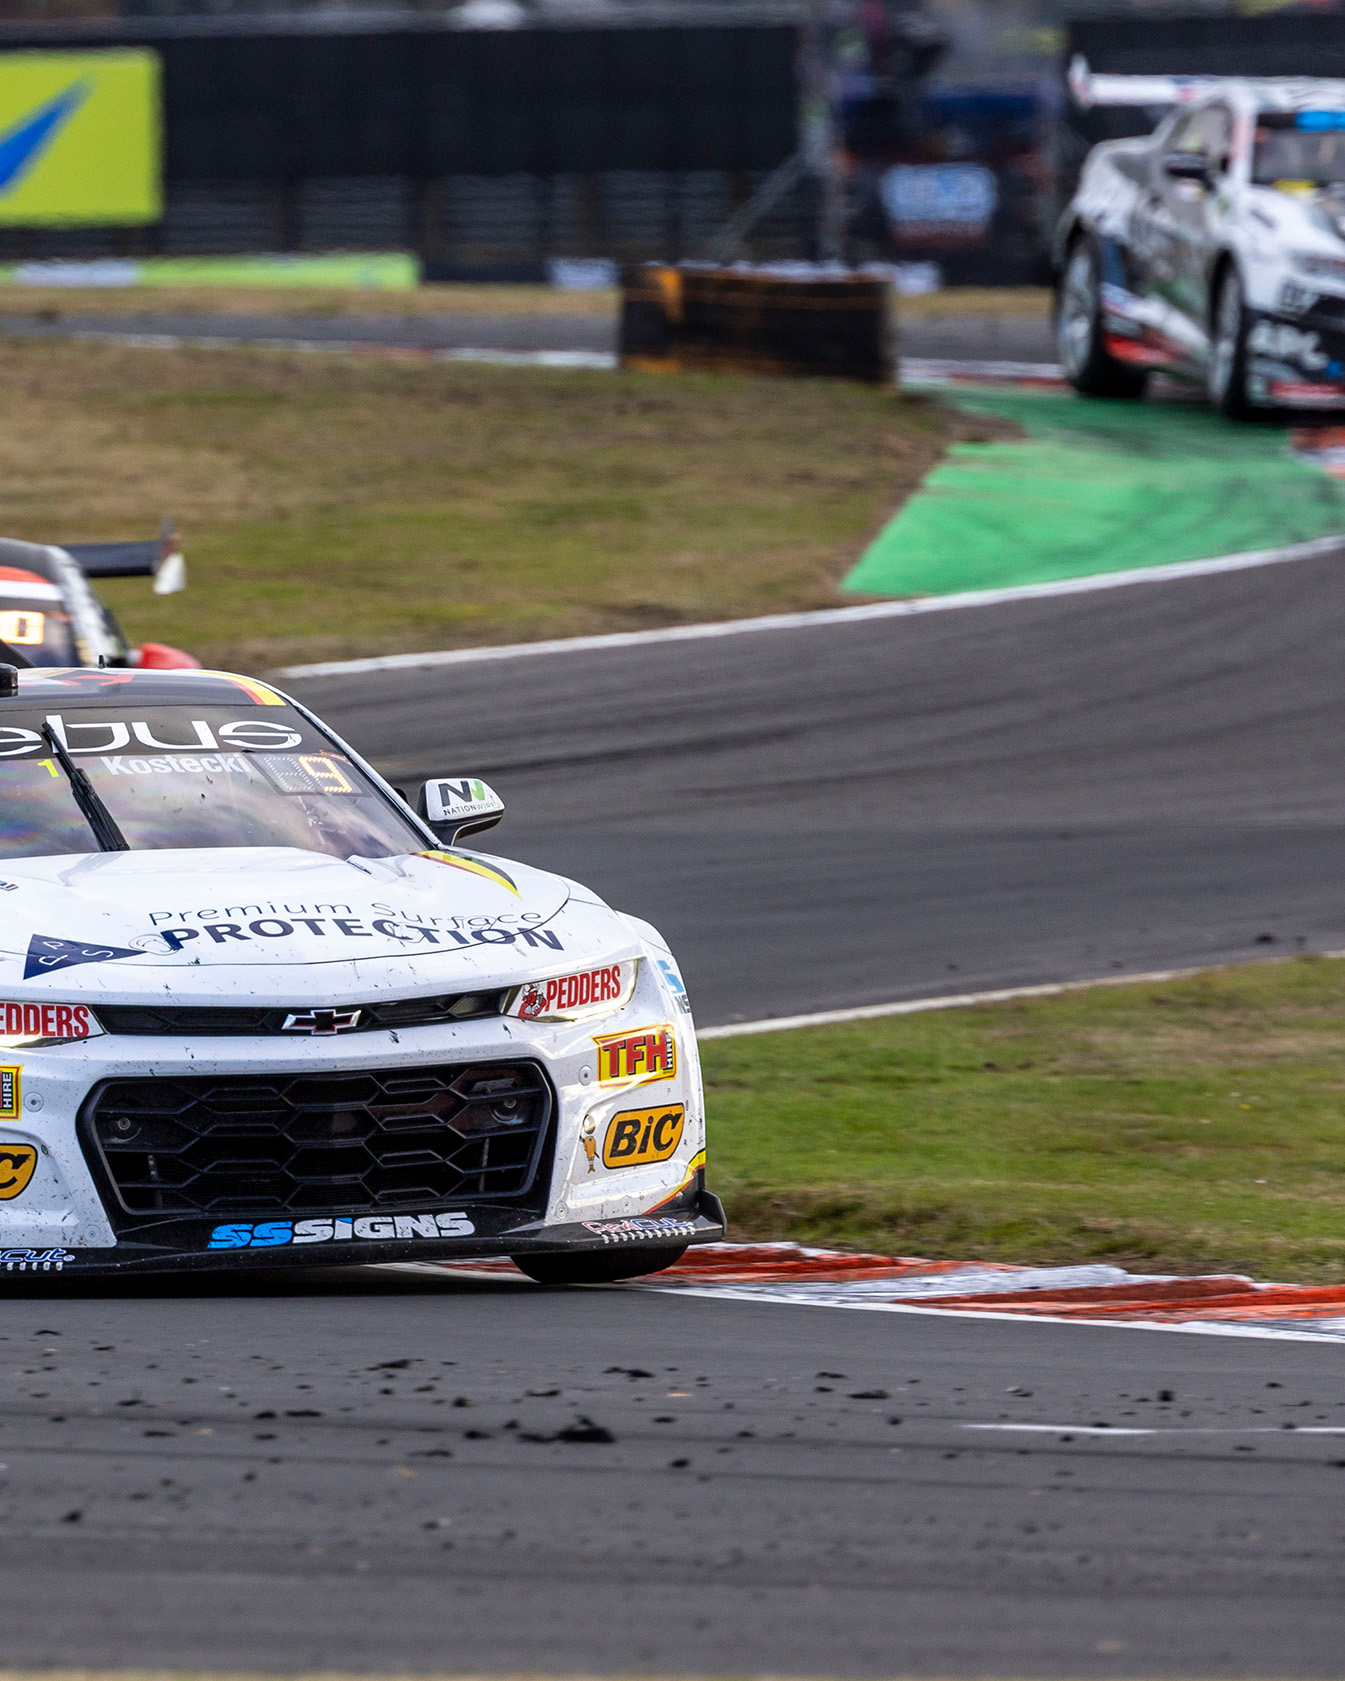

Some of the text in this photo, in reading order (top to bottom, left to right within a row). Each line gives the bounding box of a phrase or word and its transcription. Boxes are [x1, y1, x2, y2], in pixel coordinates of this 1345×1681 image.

[38, 753, 253, 778] 1 Kostecki
[299, 756, 352, 792] 9
[149, 901, 543, 929] Premium Surface
[160, 918, 564, 951] PROTECTION
[546, 965, 621, 1012] PEDDERS
[602, 1030, 667, 1077] TFH
[2, 1072, 13, 1109] HIRE
